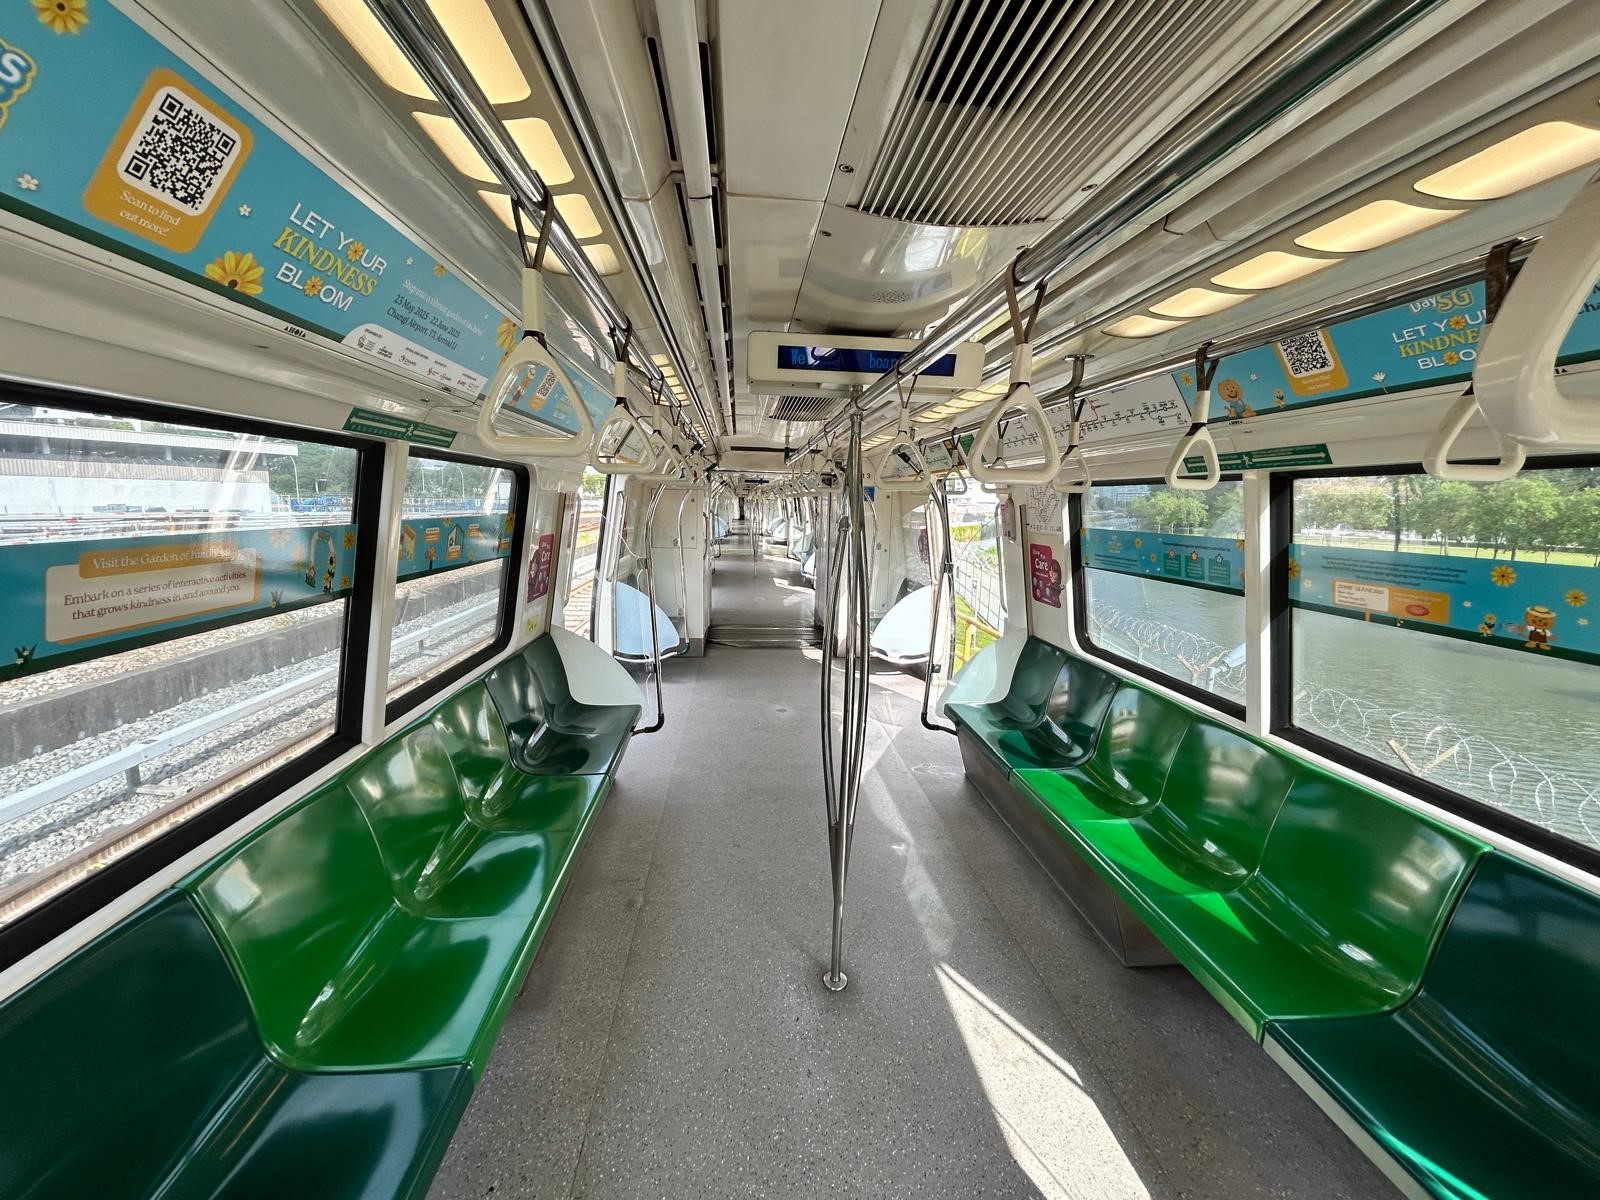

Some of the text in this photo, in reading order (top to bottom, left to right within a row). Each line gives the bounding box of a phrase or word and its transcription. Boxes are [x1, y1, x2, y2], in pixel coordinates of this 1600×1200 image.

[120, 191, 180, 226] Scan to find
[120, 210, 138, 222] out
[289, 203, 388, 276] LET YOUR
[273, 226, 378, 296] KINDNESS
[275, 262, 354, 312] BLOOM
[394, 295, 404, 305] 25
[402, 300, 416, 313] May
[415, 307, 429, 320] 2025
[1392, 309, 1487, 342] LET YOU
[1399, 328, 1480, 358] KINDNE
[1418, 349, 1477, 370] BLOO
[93, 558, 119, 570] Visit
[120, 556, 138, 567] the
[141, 551, 178, 565] Garden
[1035, 558, 1048, 571] Care
[64, 571, 246, 606] Embark on a series of interactive activities
[72, 608, 95, 620] that
[96, 602, 129, 618] grows
[130, 596, 172, 611] kindness
[172, 594, 181, 602] in
[182, 588, 198, 601] and
[198, 587, 227, 598] around
